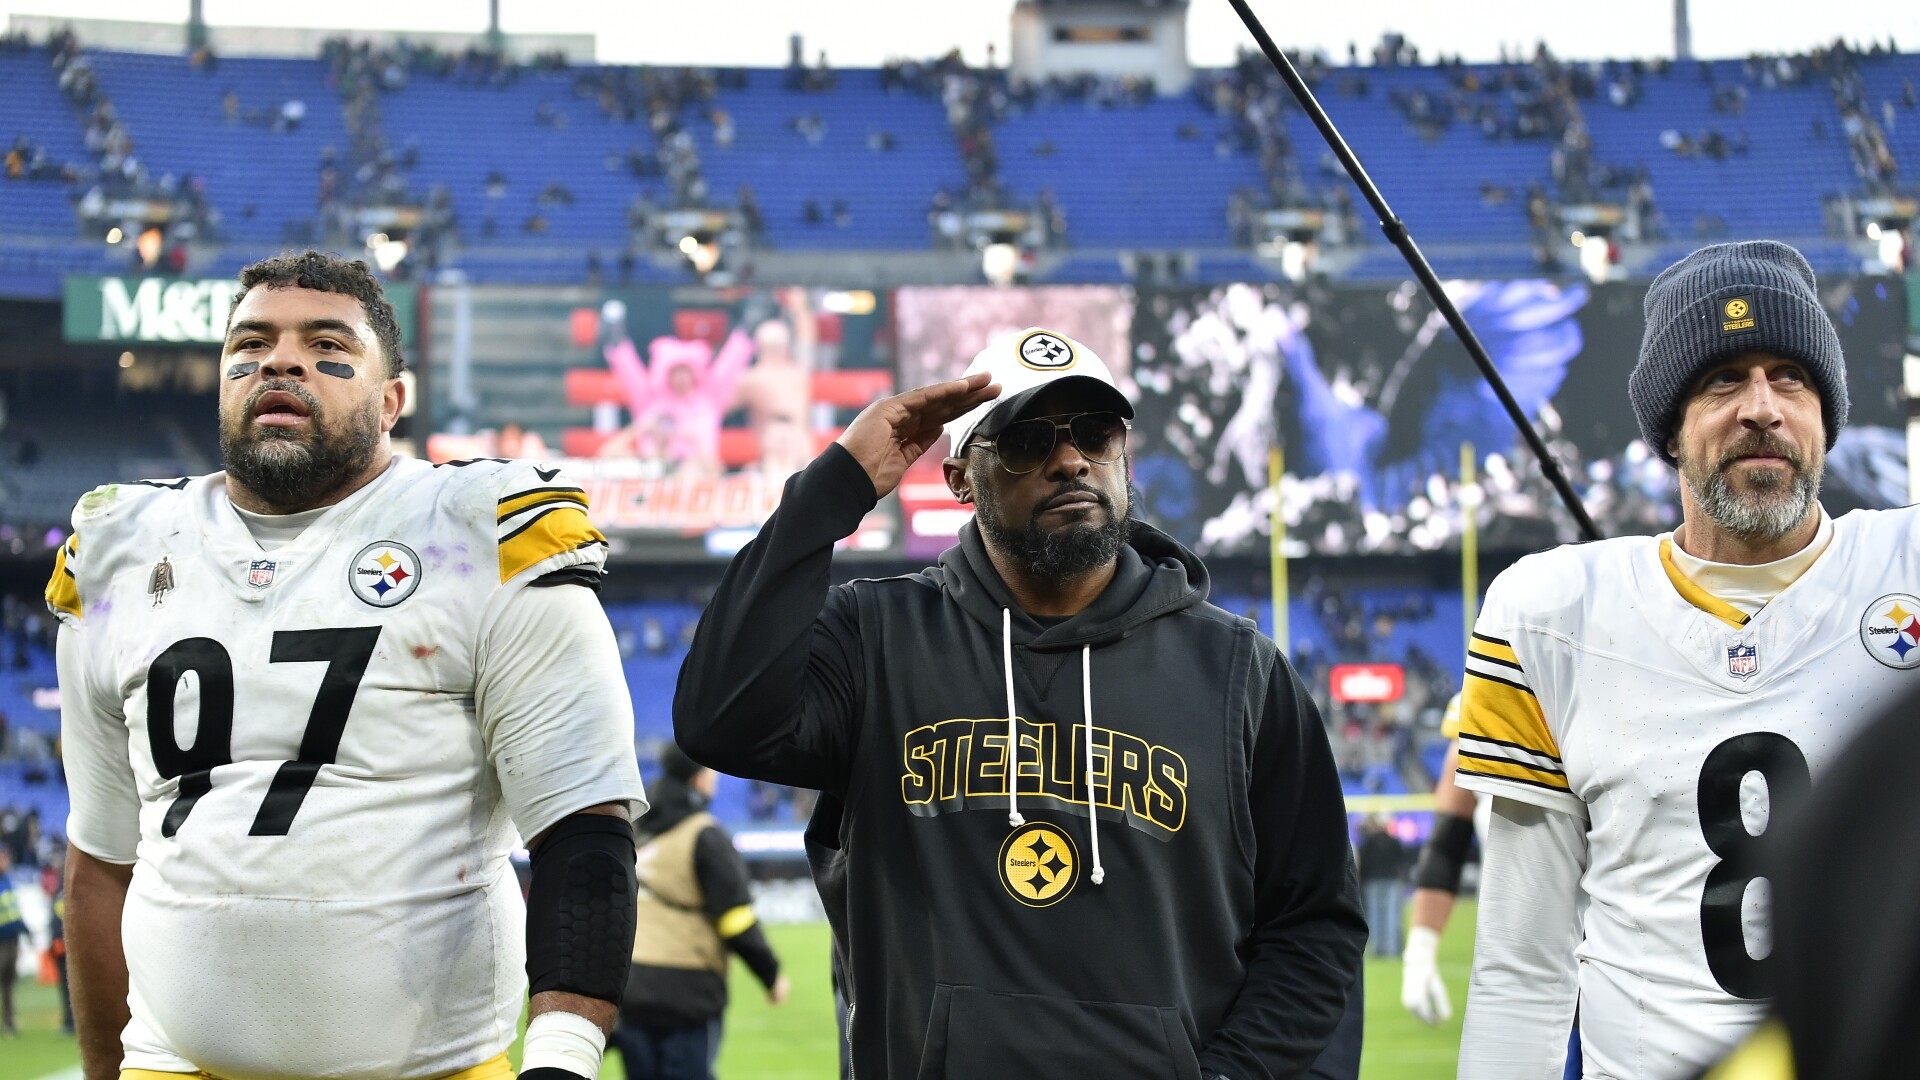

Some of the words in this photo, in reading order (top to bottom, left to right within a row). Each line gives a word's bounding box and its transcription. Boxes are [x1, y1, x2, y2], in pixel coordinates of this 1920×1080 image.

[250, 570, 271, 584] NFL
[356, 567, 383, 577] Steelers
[1868, 625, 1899, 636] Steelers
[1730, 657, 1755, 674] NFL
[146, 624, 383, 839] 97
[901, 717, 1188, 834] STEELERS
[1010, 858, 1037, 868] Steelers
[1696, 730, 1812, 1000] 8
